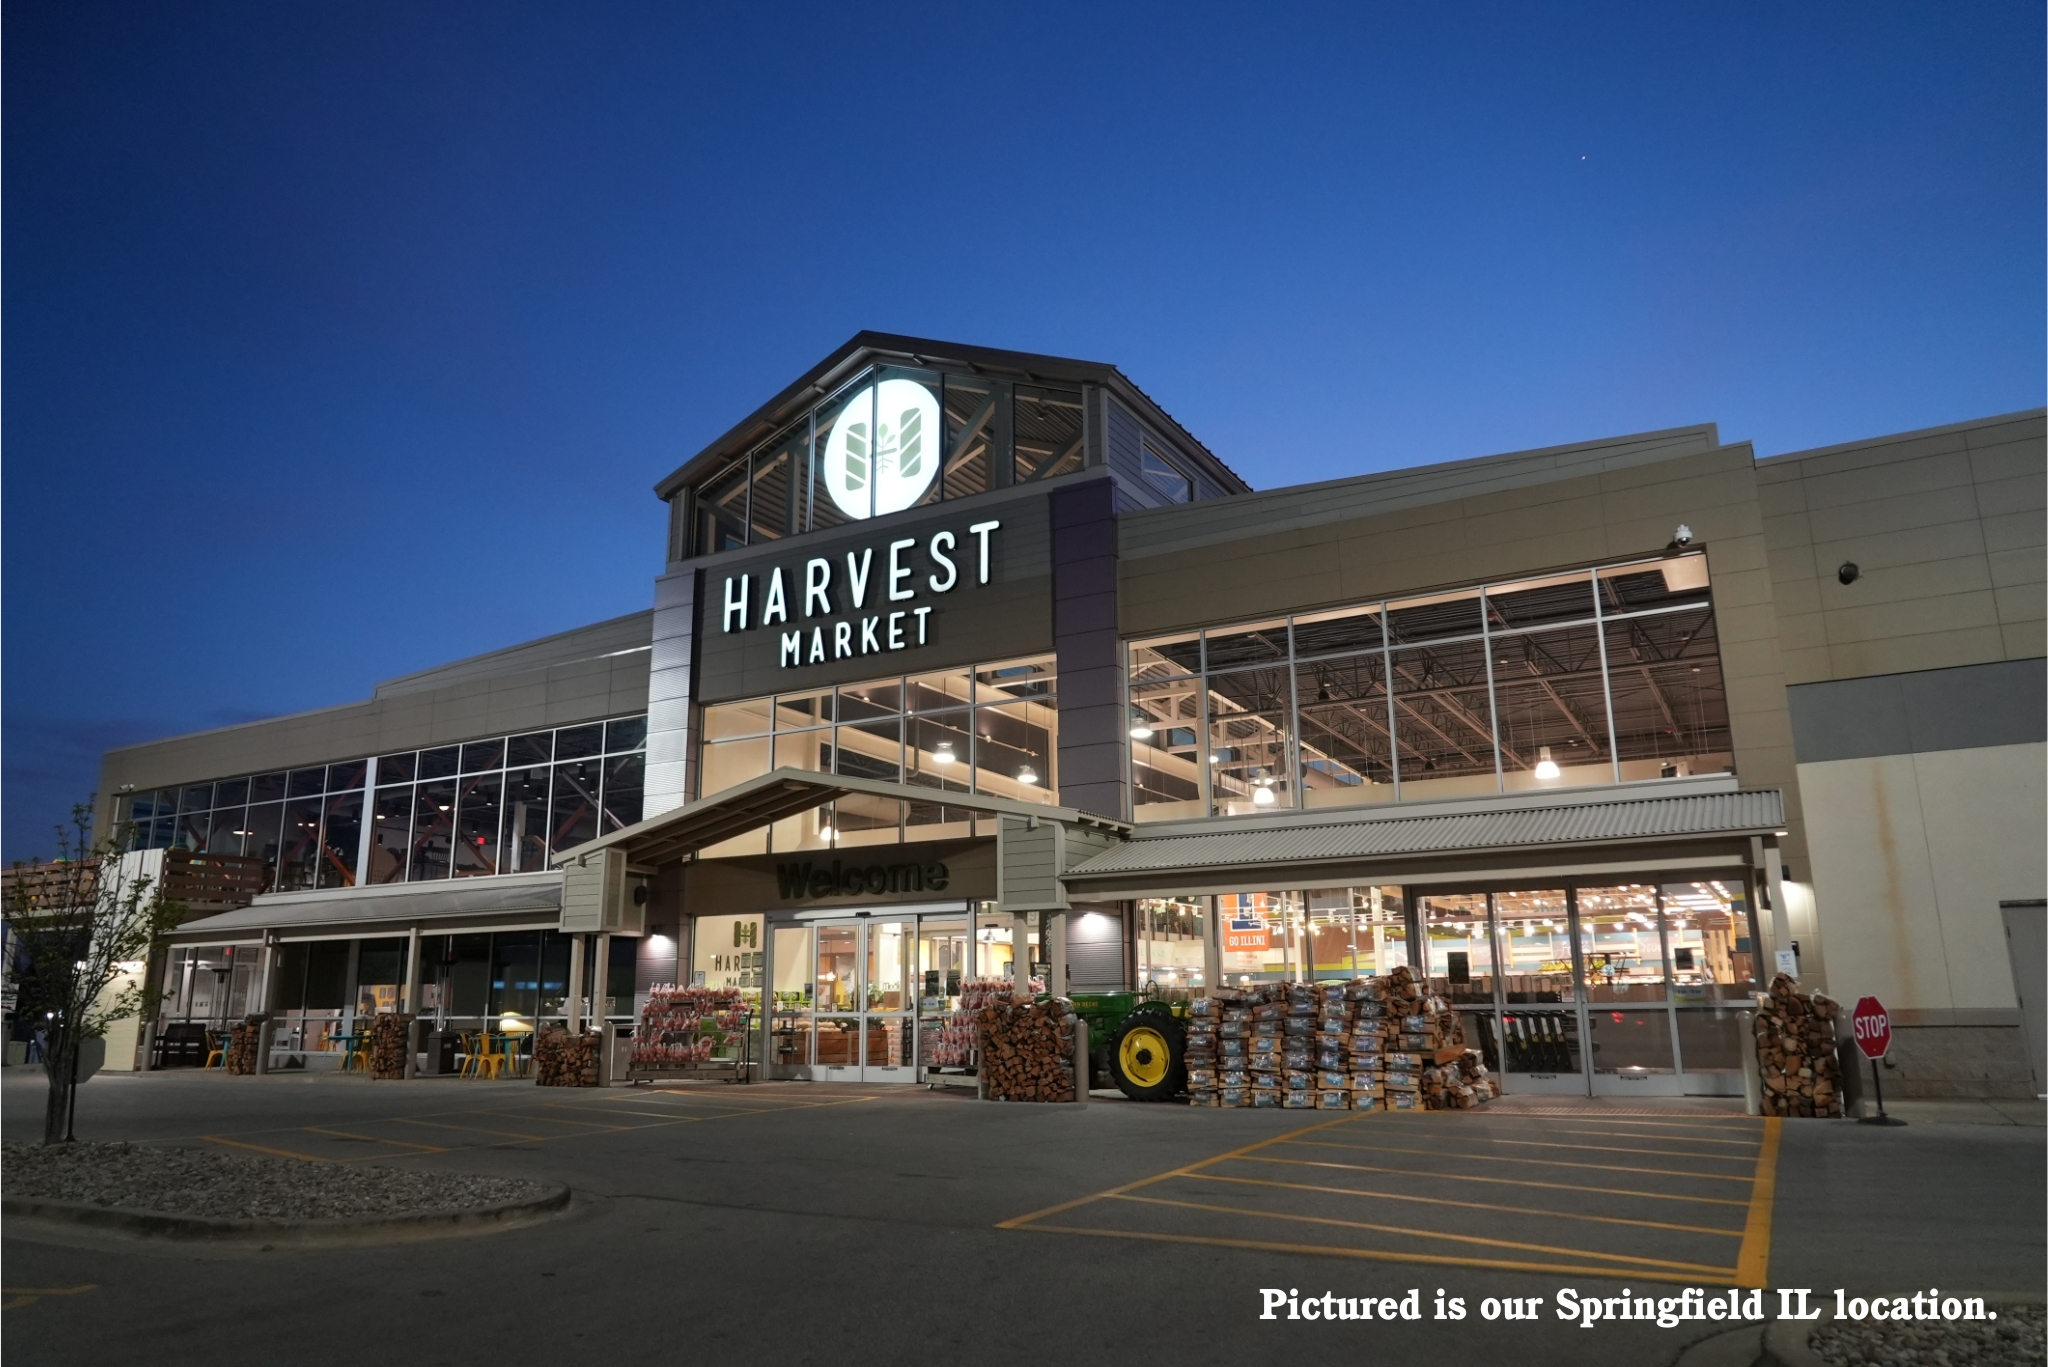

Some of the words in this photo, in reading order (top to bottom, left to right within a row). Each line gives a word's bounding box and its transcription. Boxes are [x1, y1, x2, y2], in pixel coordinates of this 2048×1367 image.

[723, 520, 1000, 633] HARVEST
[781, 606, 932, 668] MARKET
[776, 860, 950, 900] Welcome
[1229, 935, 1240, 947] GO
[1241, 934, 1266, 947] ILLINI
[1855, 1014, 1888, 1040] STOP
